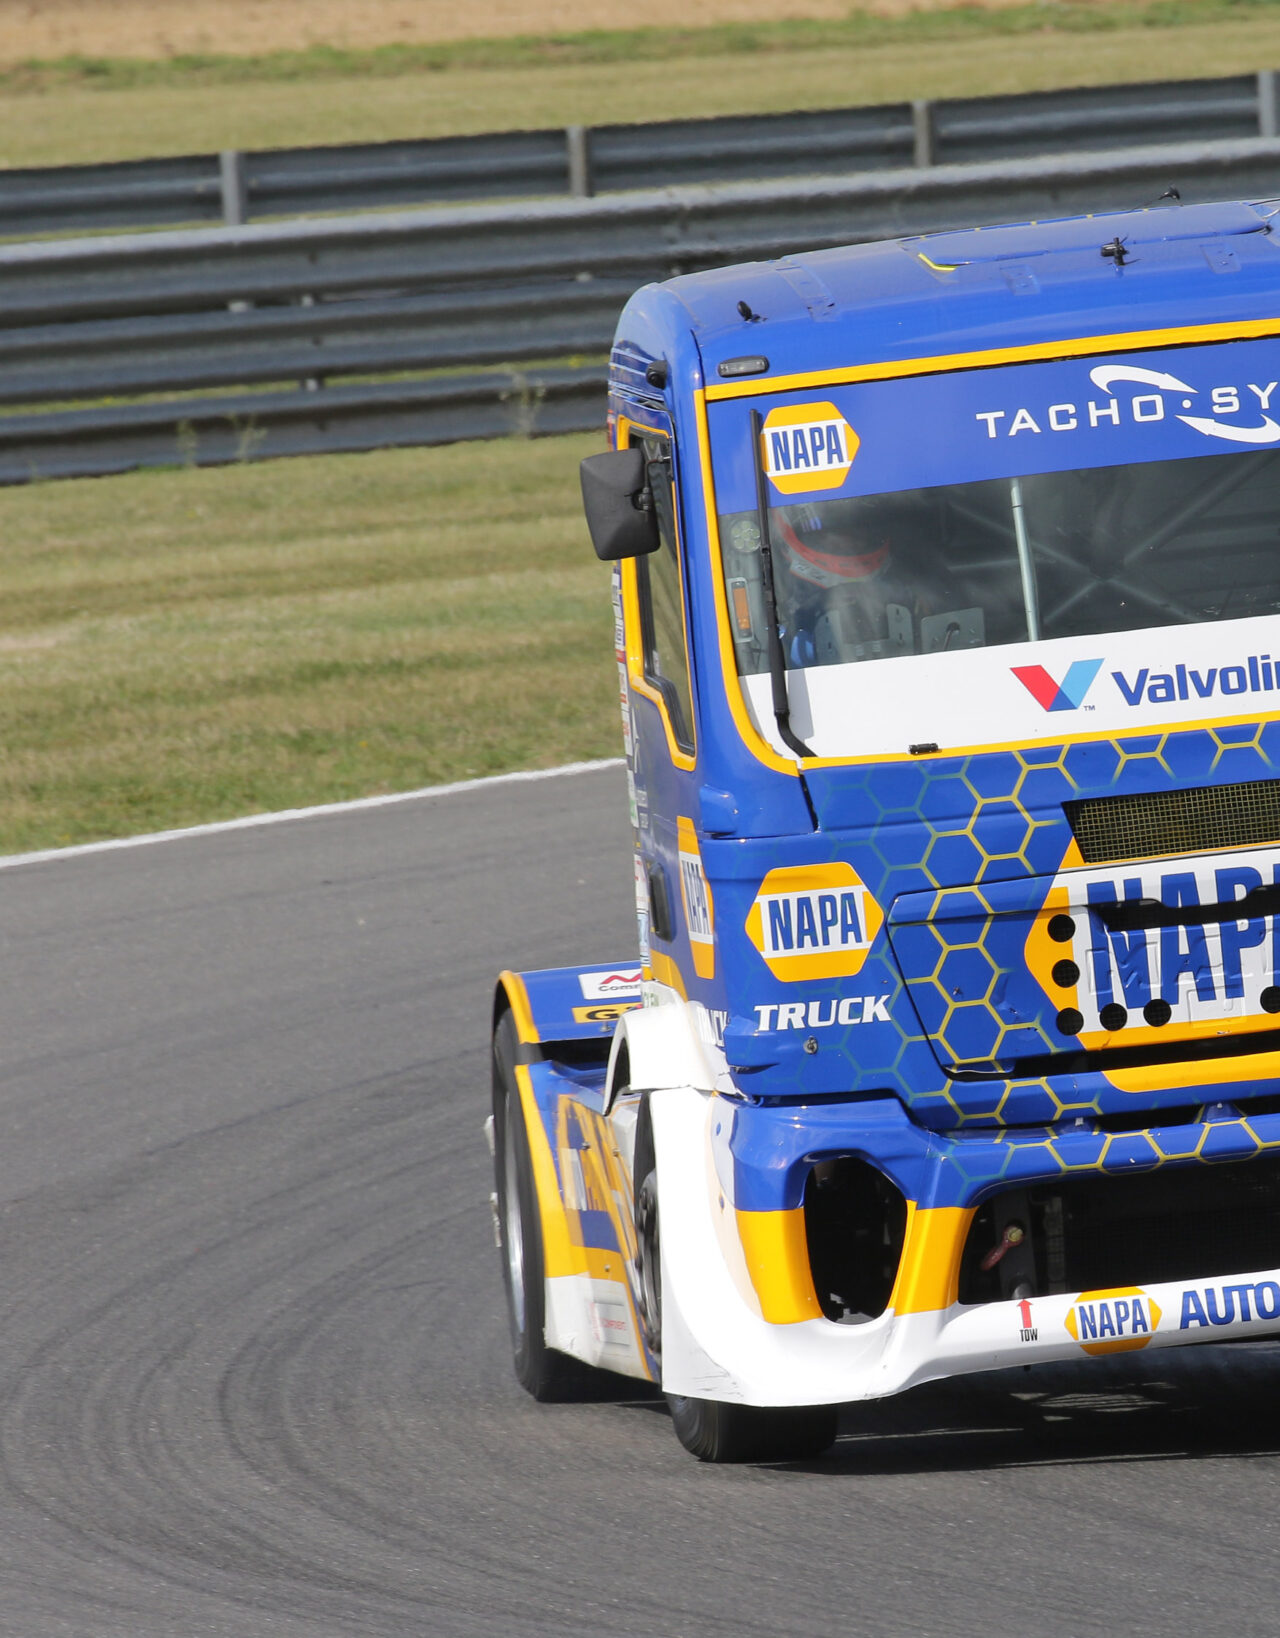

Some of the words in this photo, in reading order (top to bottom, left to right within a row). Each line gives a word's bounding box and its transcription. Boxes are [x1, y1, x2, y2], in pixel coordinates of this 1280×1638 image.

[771, 424, 844, 471] NAPA
[768, 892, 863, 951] NAPA
[754, 994, 892, 1032] TRUCK
[1020, 1328, 1038, 1342] TOW
[1078, 1298, 1149, 1340] NAPA
